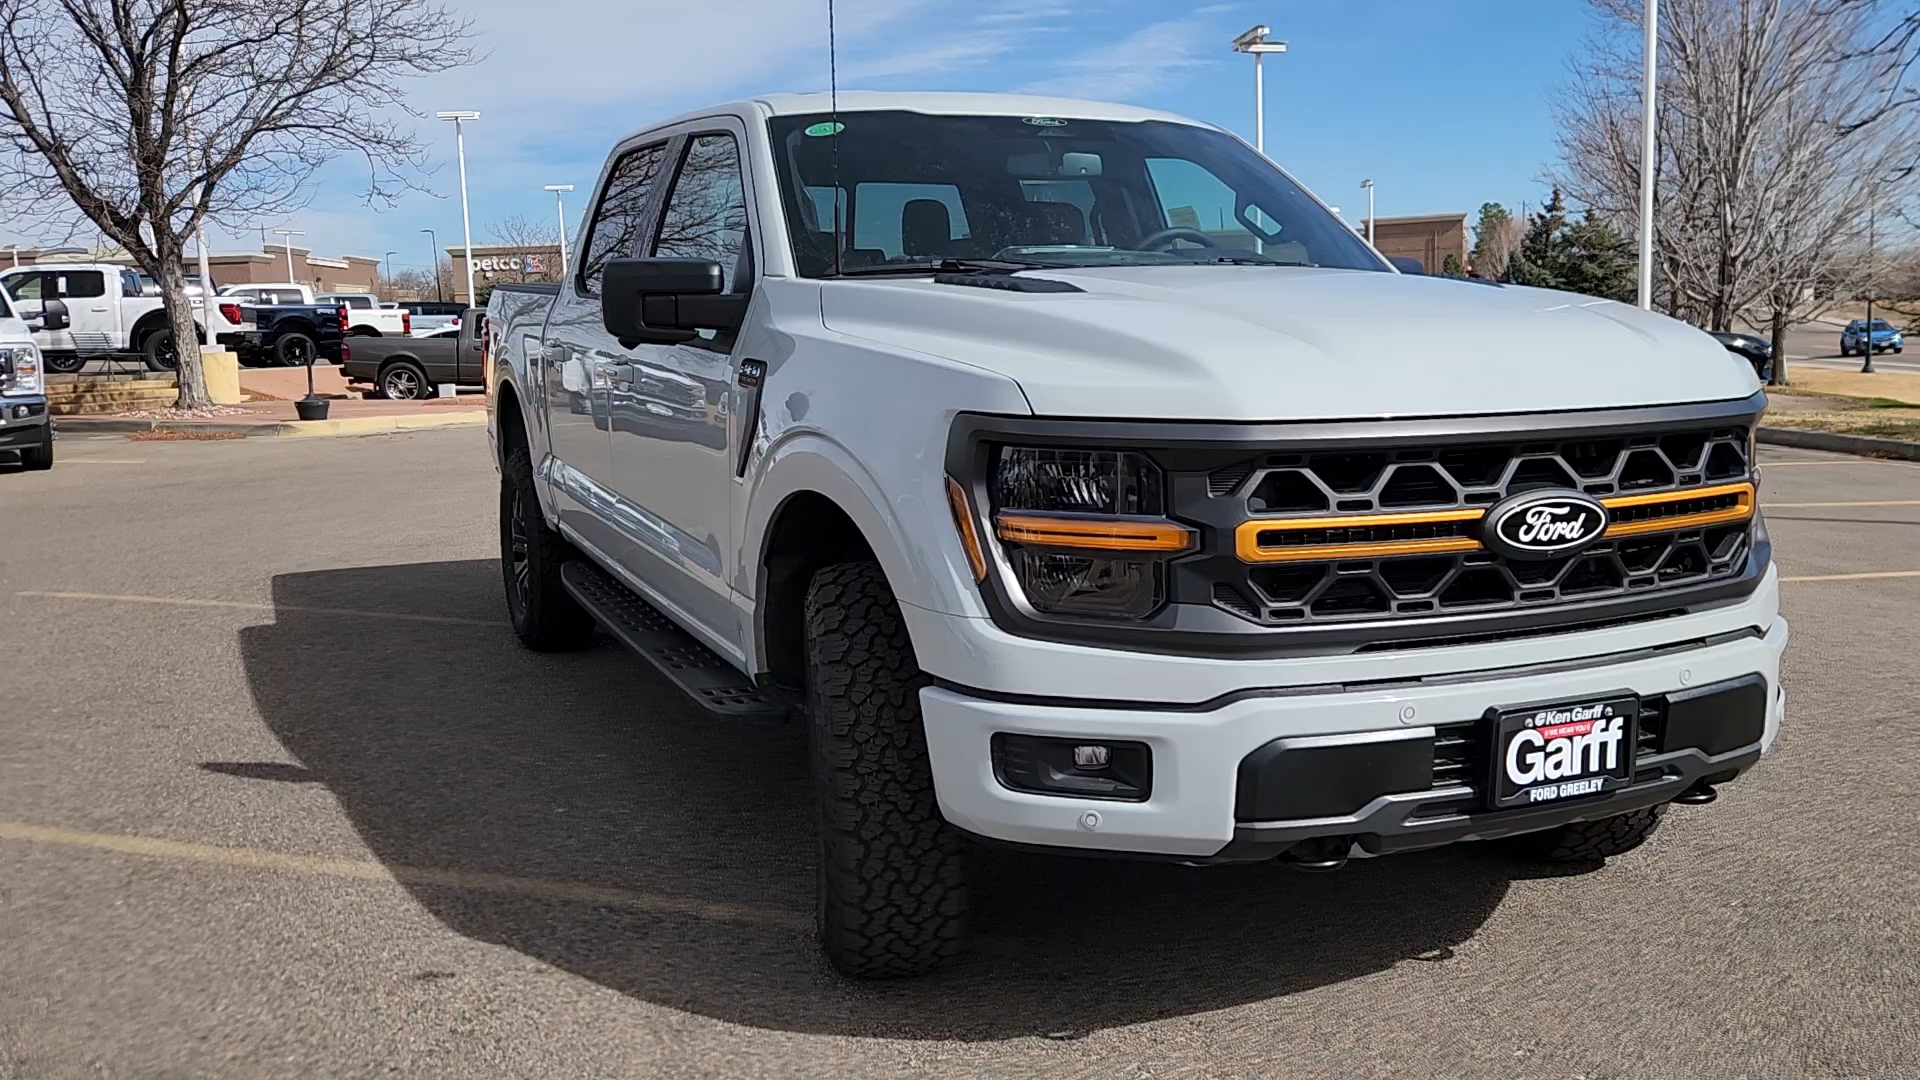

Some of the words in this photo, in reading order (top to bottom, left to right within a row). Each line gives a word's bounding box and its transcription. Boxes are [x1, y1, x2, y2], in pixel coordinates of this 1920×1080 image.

[471, 256, 520, 273] petco
[1518, 506, 1587, 542] Ford
[1546, 711, 1571, 725] Ken
[1571, 705, 1603, 720] Garff
[1559, 725, 1575, 735] HEAR
[1506, 717, 1623, 785] Garff
[1530, 786, 1558, 802] FORD
[1559, 779, 1603, 797] GREELEY
